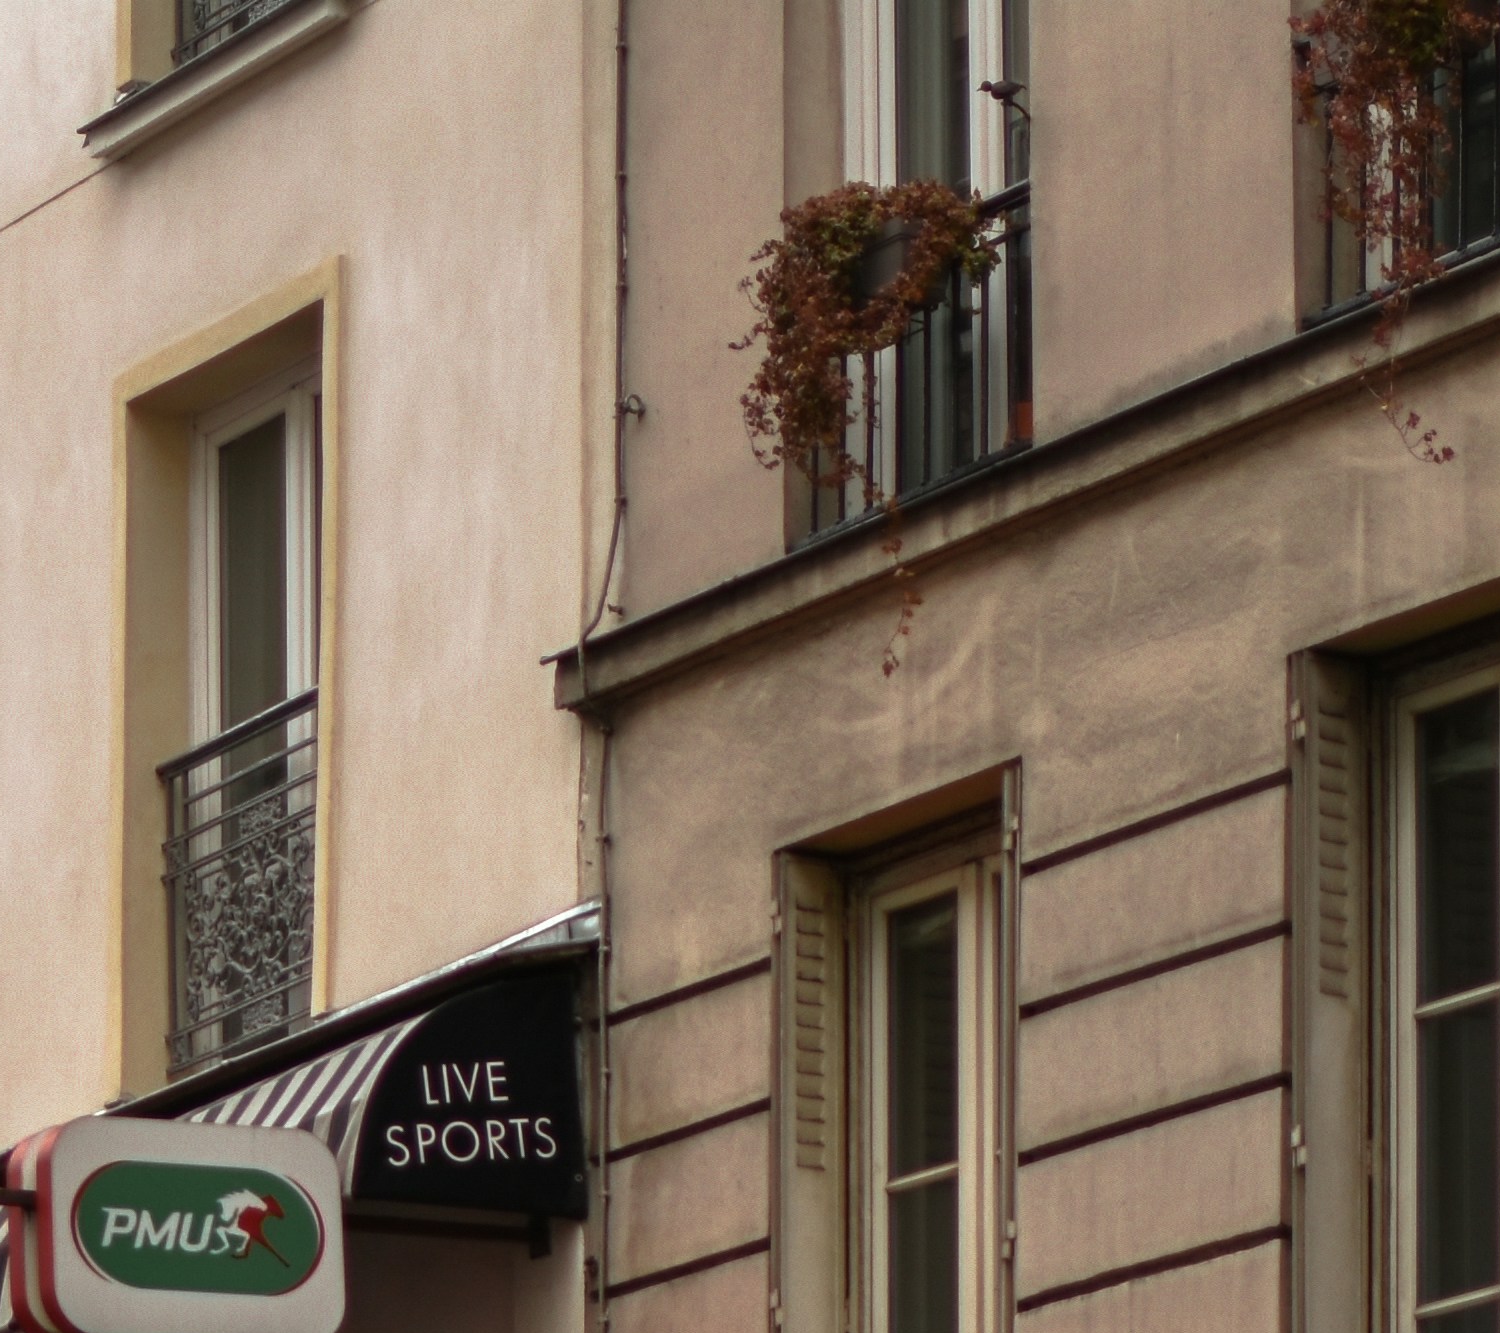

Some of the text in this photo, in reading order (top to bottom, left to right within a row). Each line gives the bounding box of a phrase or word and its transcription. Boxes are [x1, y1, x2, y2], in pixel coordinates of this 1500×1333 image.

[422, 1061, 509, 1106] LIVE
[386, 1116, 557, 1167] SPORTS
[100, 1205, 214, 1254] PMU
